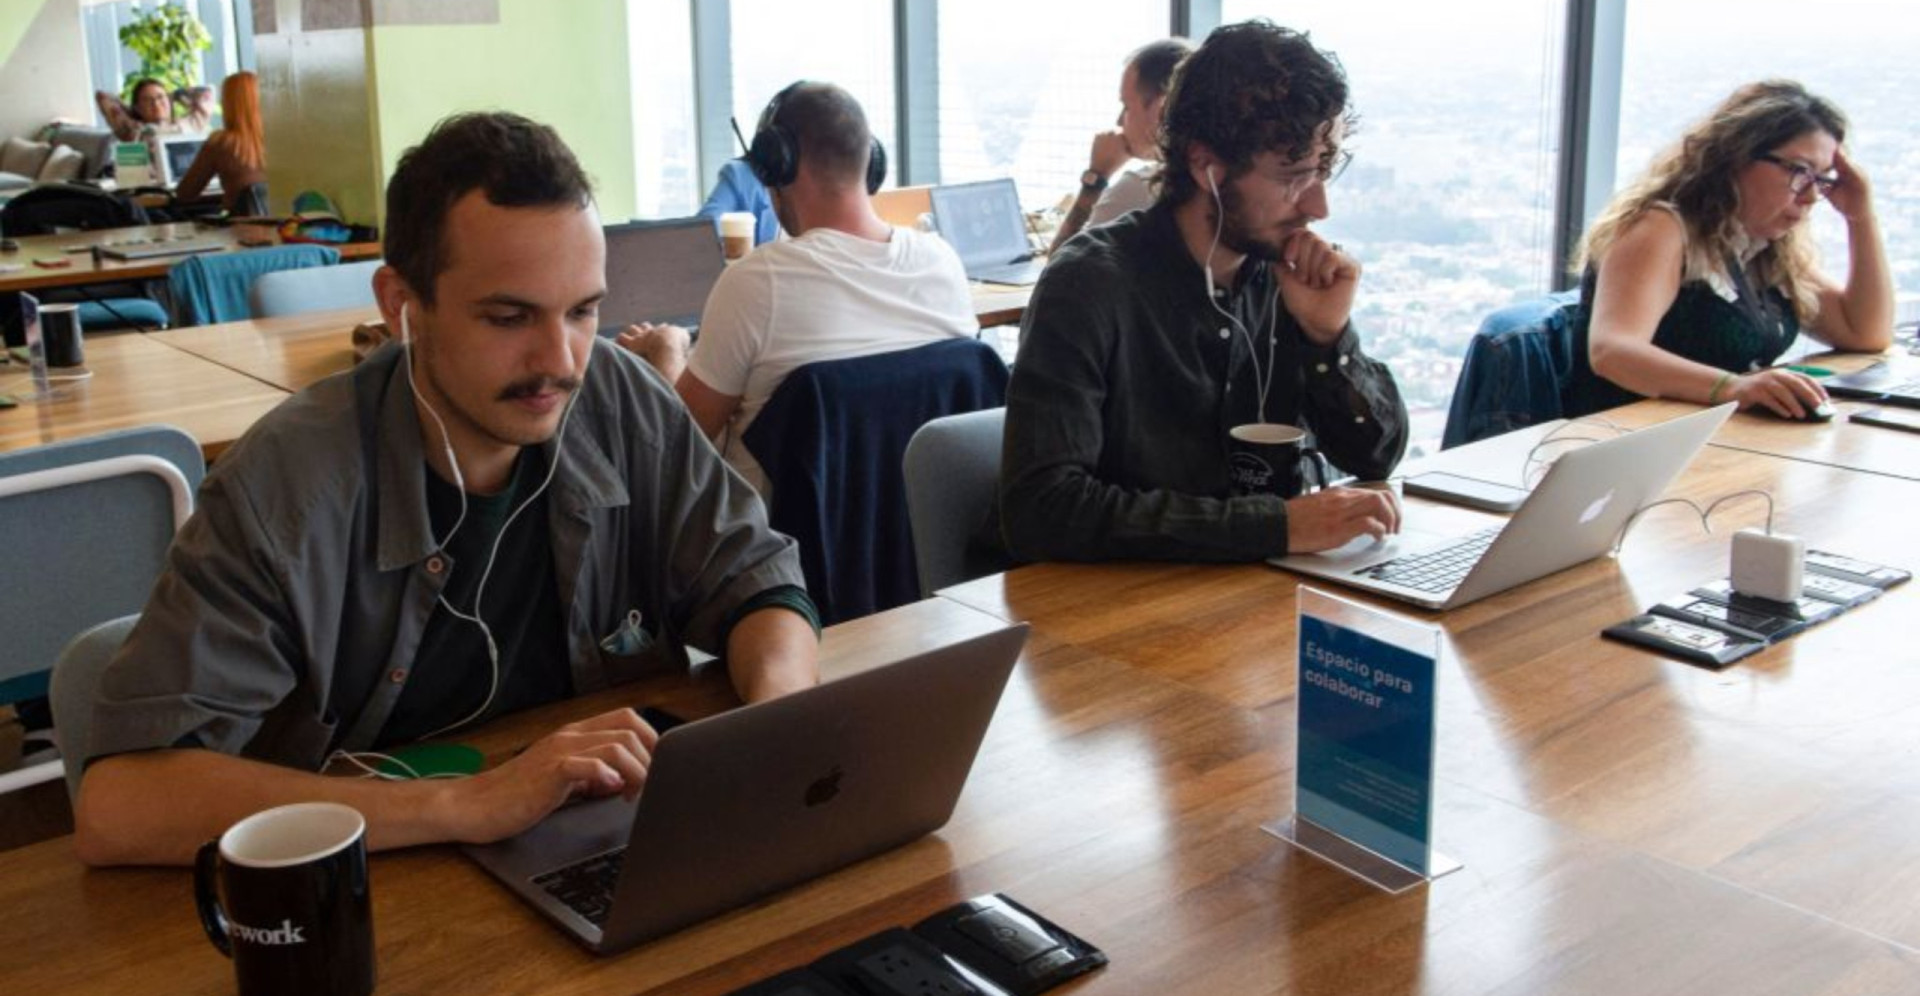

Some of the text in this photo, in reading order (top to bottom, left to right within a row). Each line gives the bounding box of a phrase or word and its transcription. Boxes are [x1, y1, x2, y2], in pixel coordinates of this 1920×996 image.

[1305, 641, 1413, 694] Espacio para
[1305, 670, 1384, 708] colaborar
